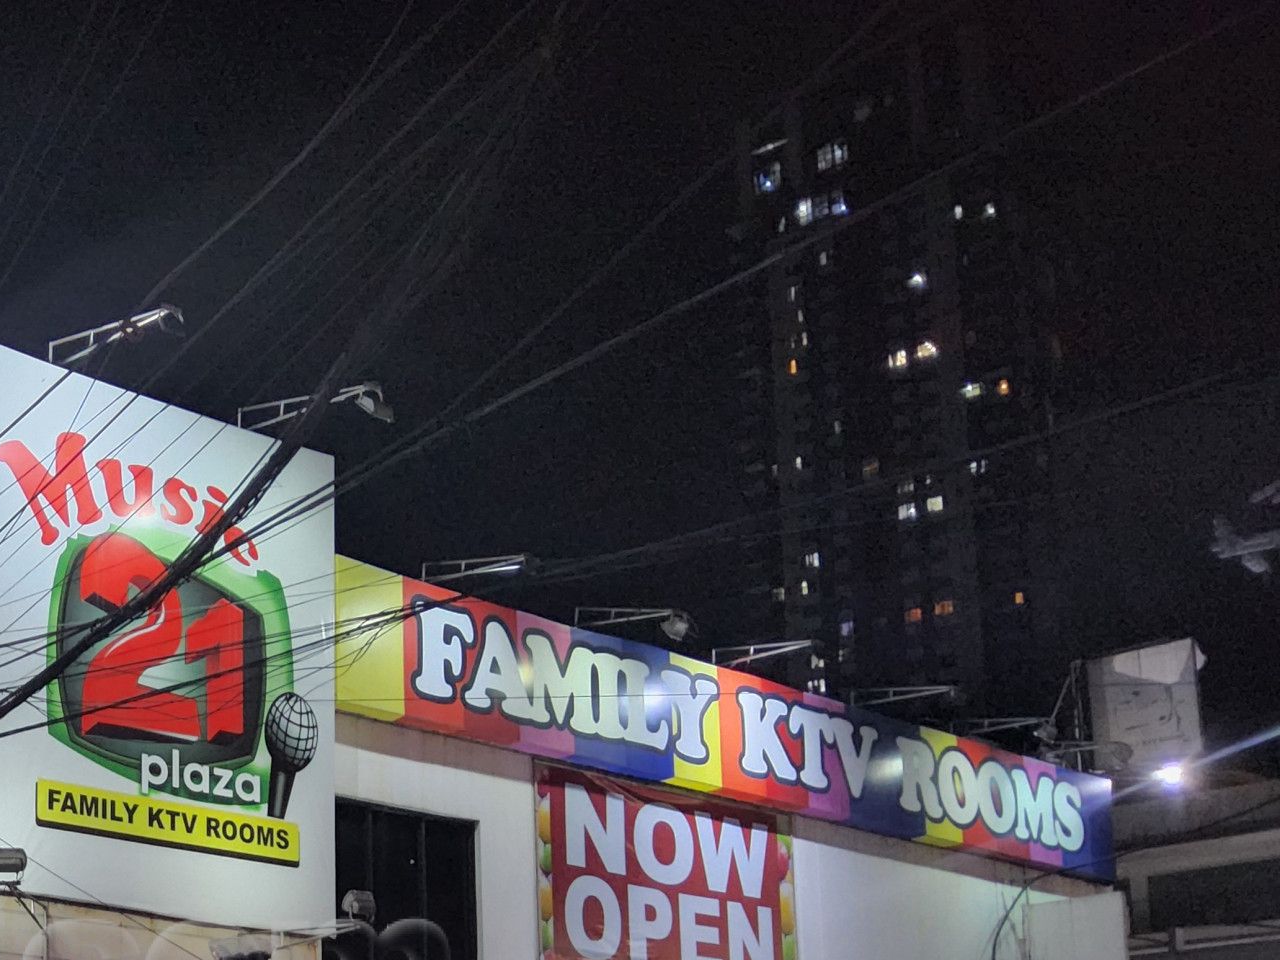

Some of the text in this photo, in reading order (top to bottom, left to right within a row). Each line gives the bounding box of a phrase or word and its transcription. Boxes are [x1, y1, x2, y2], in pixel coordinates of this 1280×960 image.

[79, 530, 245, 744] 21
[140, 748, 263, 804] plaza
[412, 602, 1087, 853] FAMILY KTV ROOMS
[47, 788, 290, 850] FAMILY KTV ROOMS
[564, 782, 768, 899] NOW
